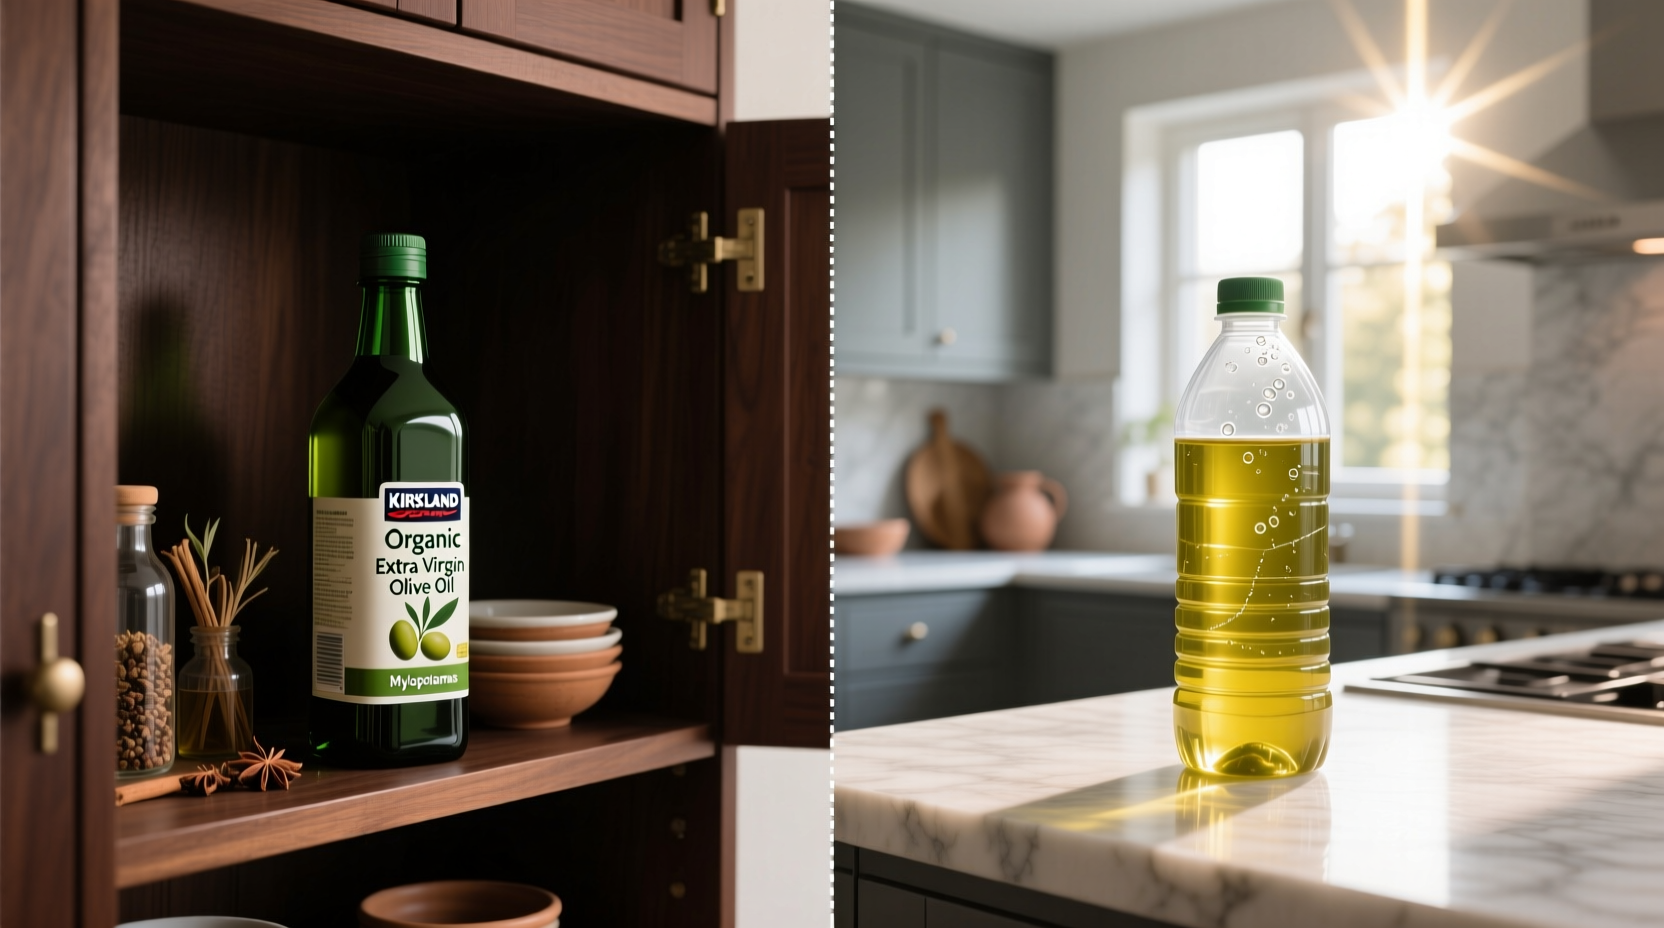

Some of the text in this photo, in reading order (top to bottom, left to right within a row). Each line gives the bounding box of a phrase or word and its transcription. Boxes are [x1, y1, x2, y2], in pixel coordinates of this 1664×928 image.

[384, 527, 461, 555] Organic
[375, 556, 465, 577] Extra Virgin
[389, 575, 454, 596] Olive Oil
